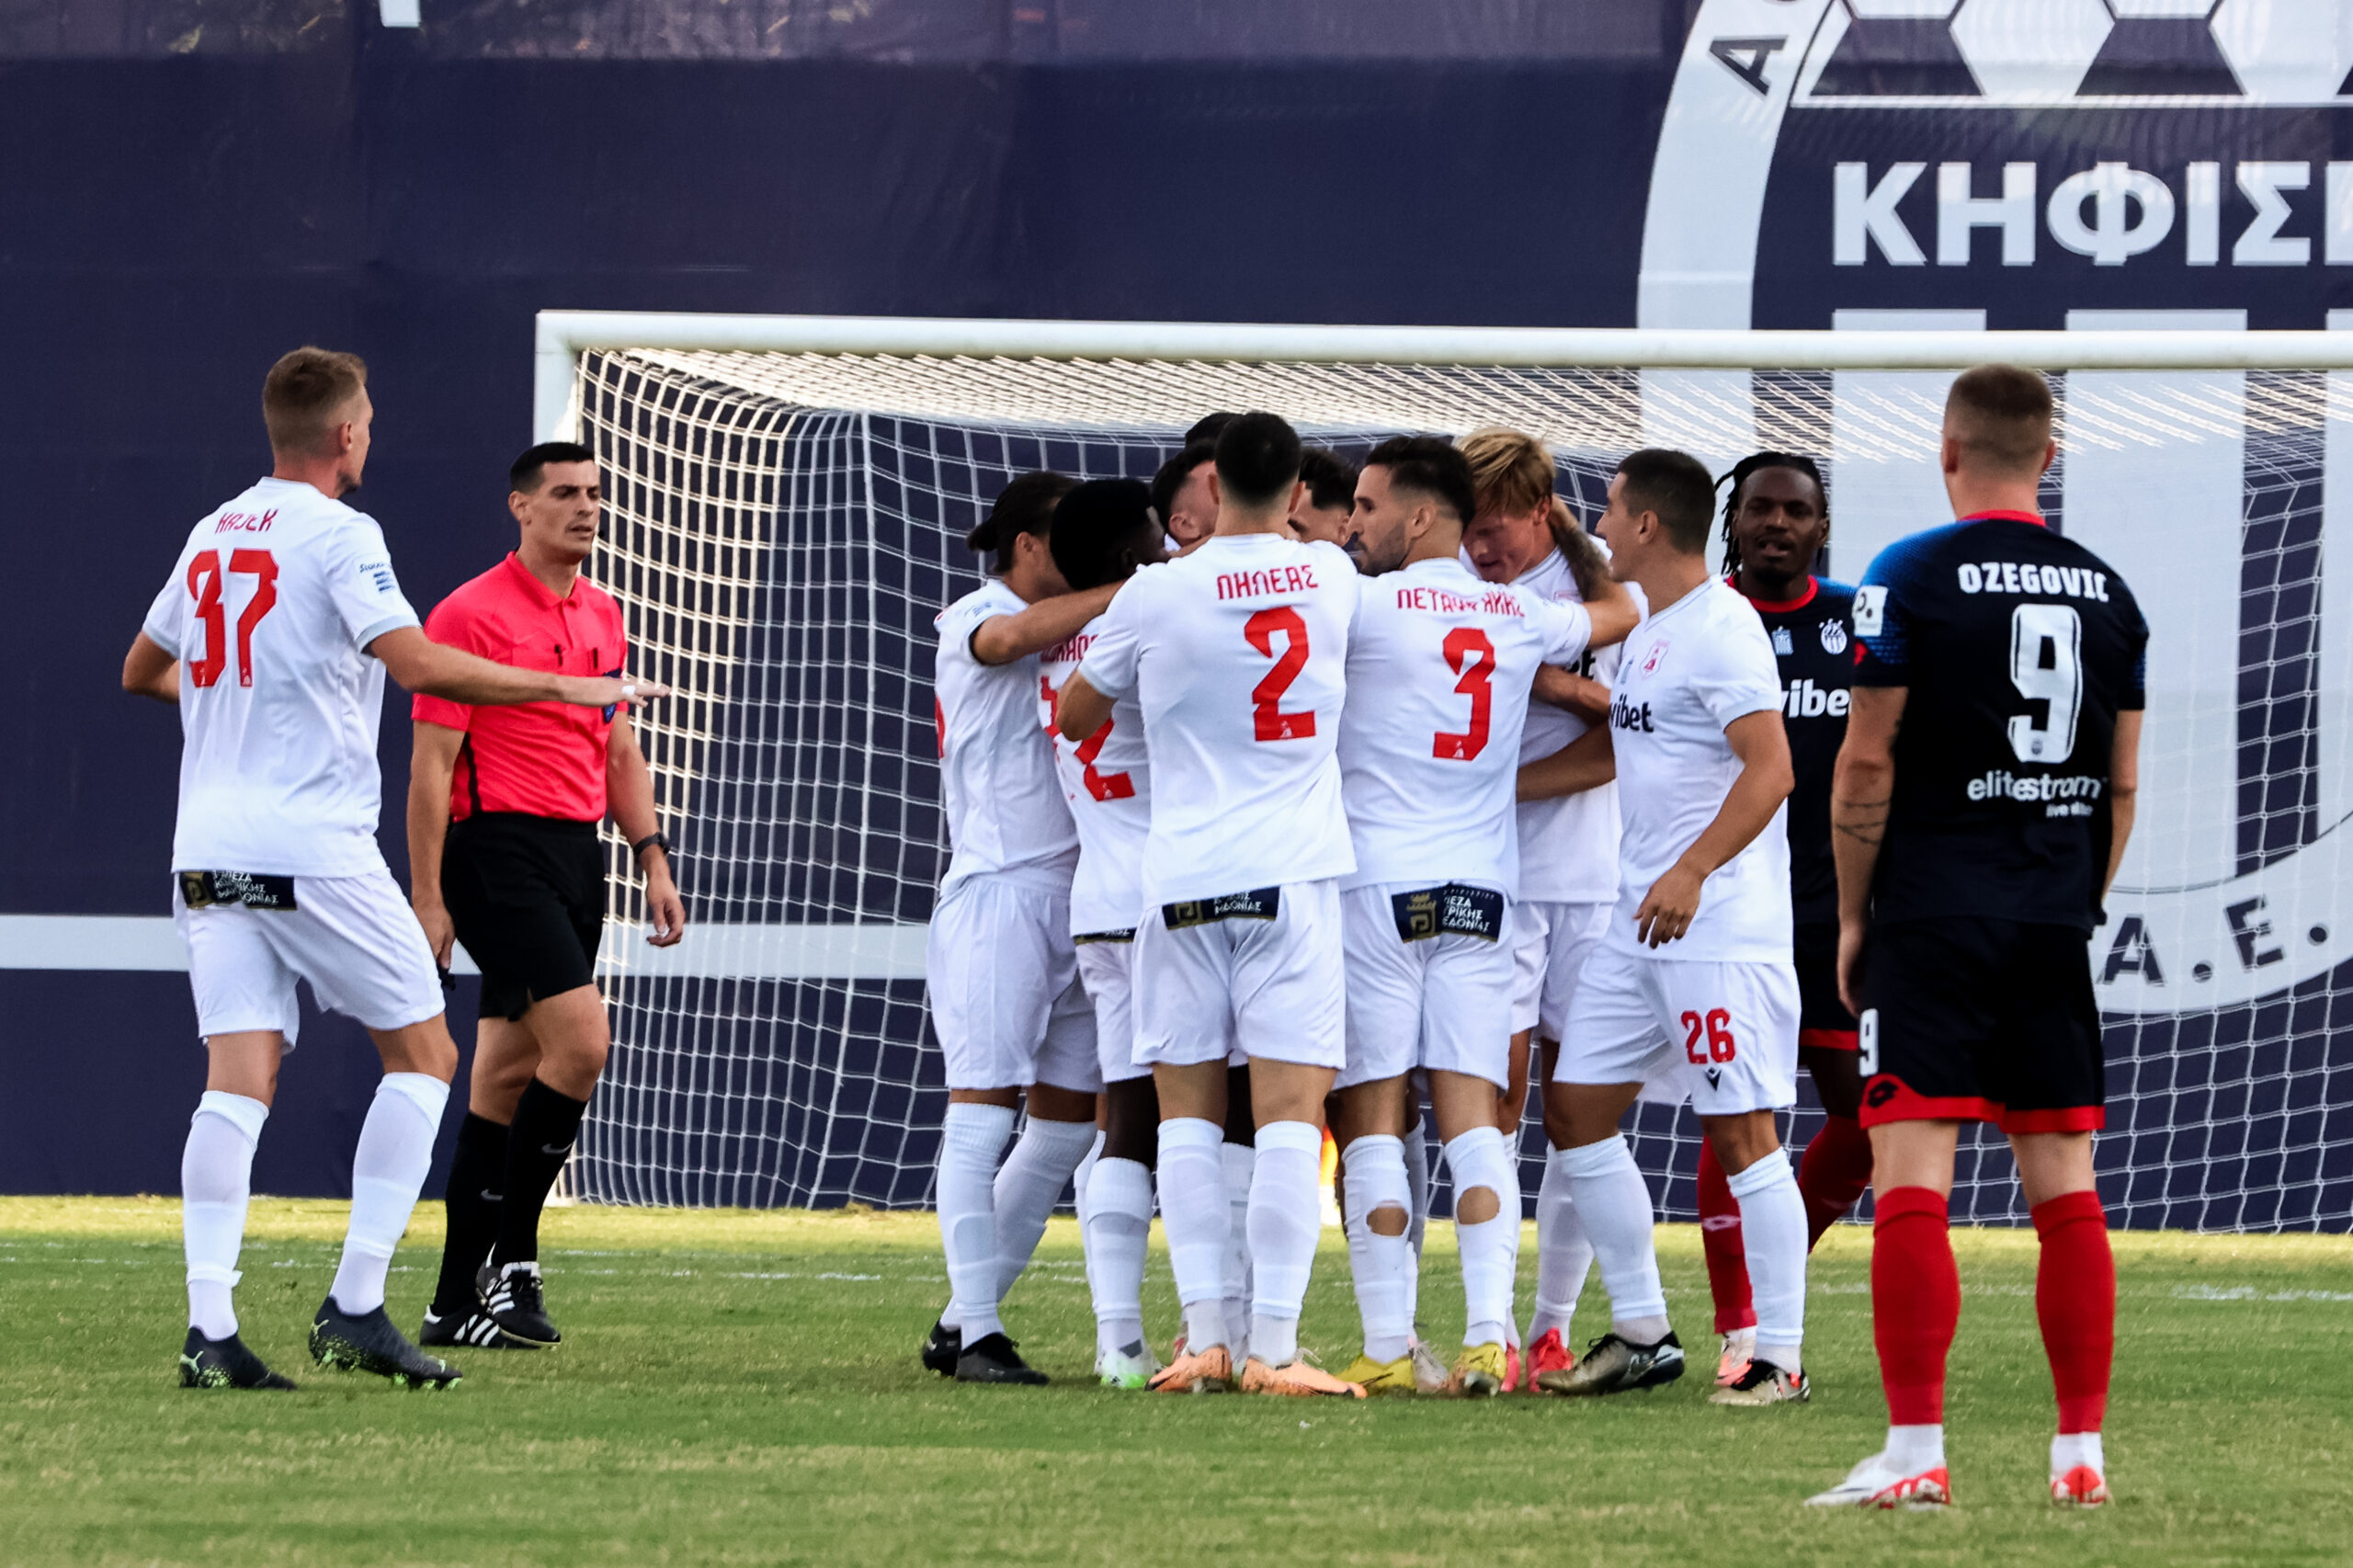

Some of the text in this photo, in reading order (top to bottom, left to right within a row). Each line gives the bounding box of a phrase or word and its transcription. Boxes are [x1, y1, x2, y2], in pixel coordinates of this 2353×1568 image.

[1957, 562, 2109, 603] OZEGOVIC
[187, 548, 278, 688] 37
[1244, 605, 1317, 742] 2
[1432, 627, 1496, 762] 3
[1781, 678, 1852, 718] ibe
[2007, 603, 2084, 764] 9
[1967, 769, 2102, 801] elitestrom
[1680, 1007, 1736, 1064] 26
[1859, 1008, 1879, 1077] 9
